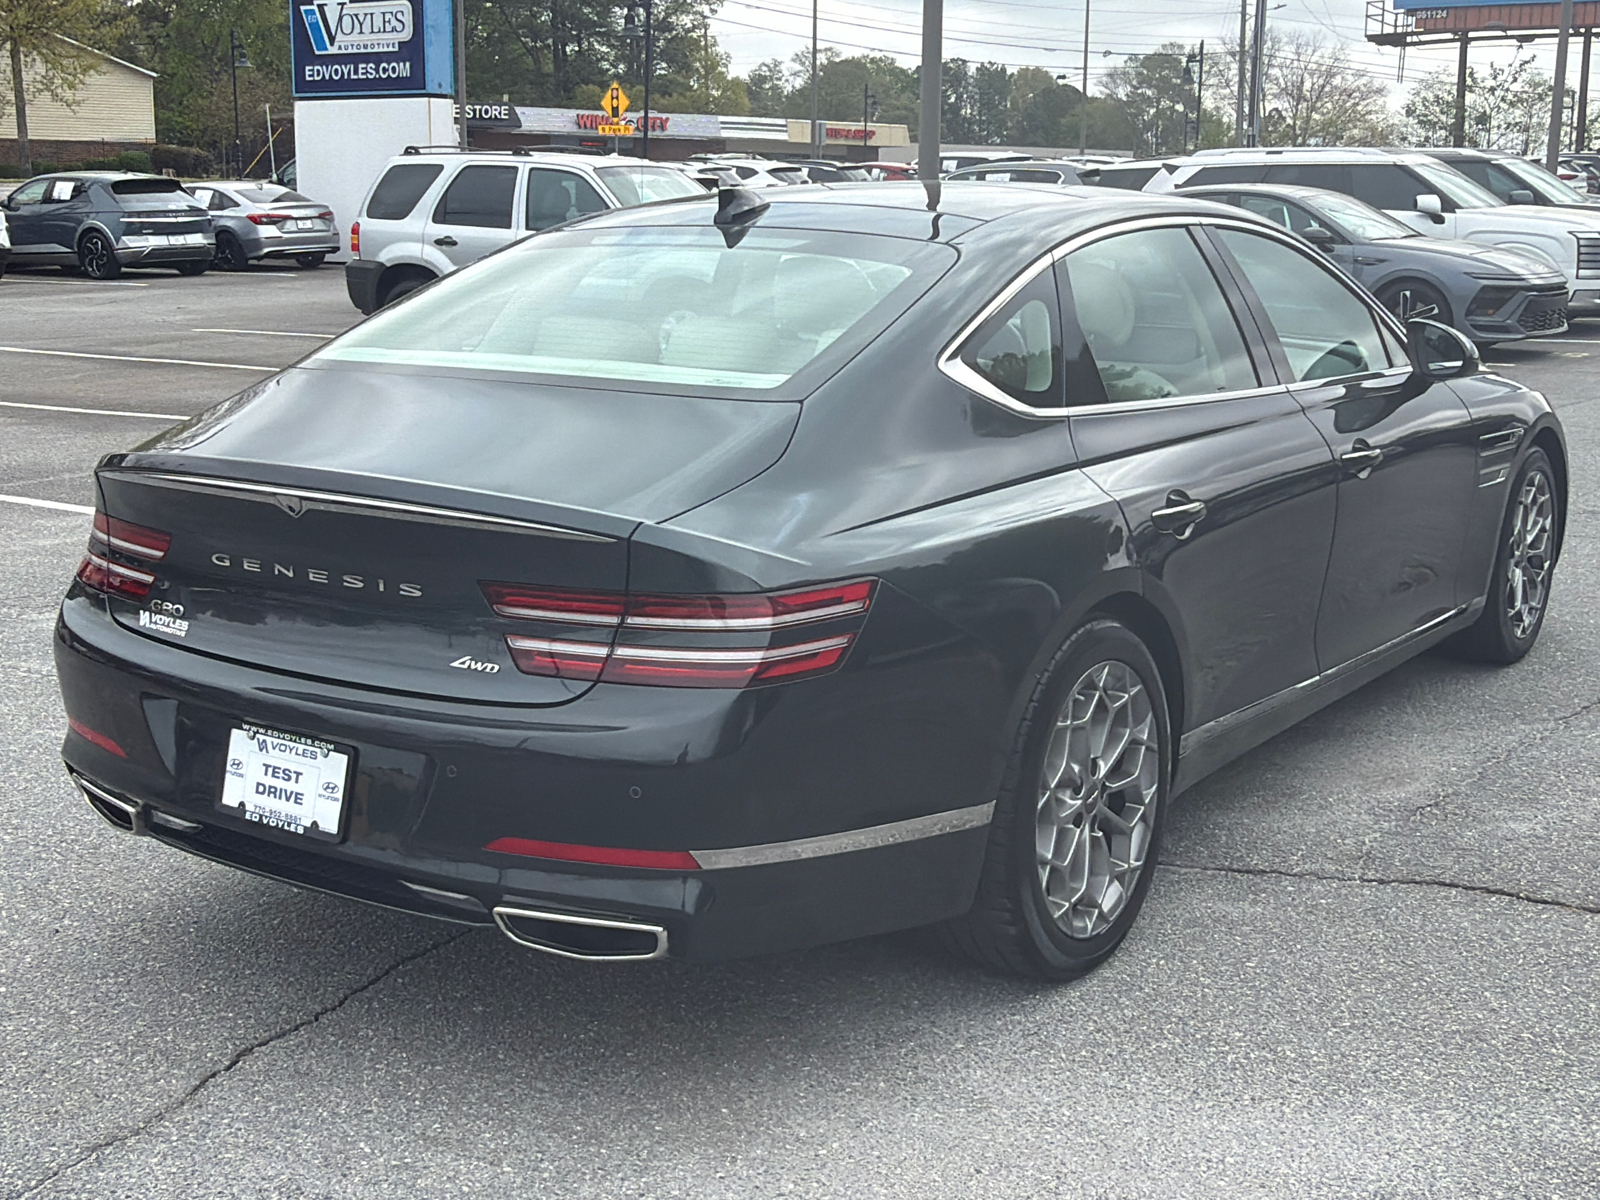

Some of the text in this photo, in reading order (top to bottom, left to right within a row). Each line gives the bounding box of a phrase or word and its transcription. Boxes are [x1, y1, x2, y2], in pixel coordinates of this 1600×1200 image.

[316, 2, 405, 47] VOYLES
[337, 42, 397, 51] AUTOMOTIVE
[305, 61, 411, 81] EDVOYLES.COM
[465, 104, 509, 119] STORE
[608, 126, 621, 134] Park
[211, 552, 424, 598] GENESIS
[151, 599, 185, 617] G80
[151, 612, 189, 631] VOYLES
[449, 655, 500, 673] 4WD
[242, 723, 335, 750] WWW.EDVOYLES.COM
[271, 741, 318, 761] VOYLES
[262, 763, 303, 784] TEST
[255, 782, 305, 806] DRIVE
[245, 811, 305, 835] ED VOYLES
